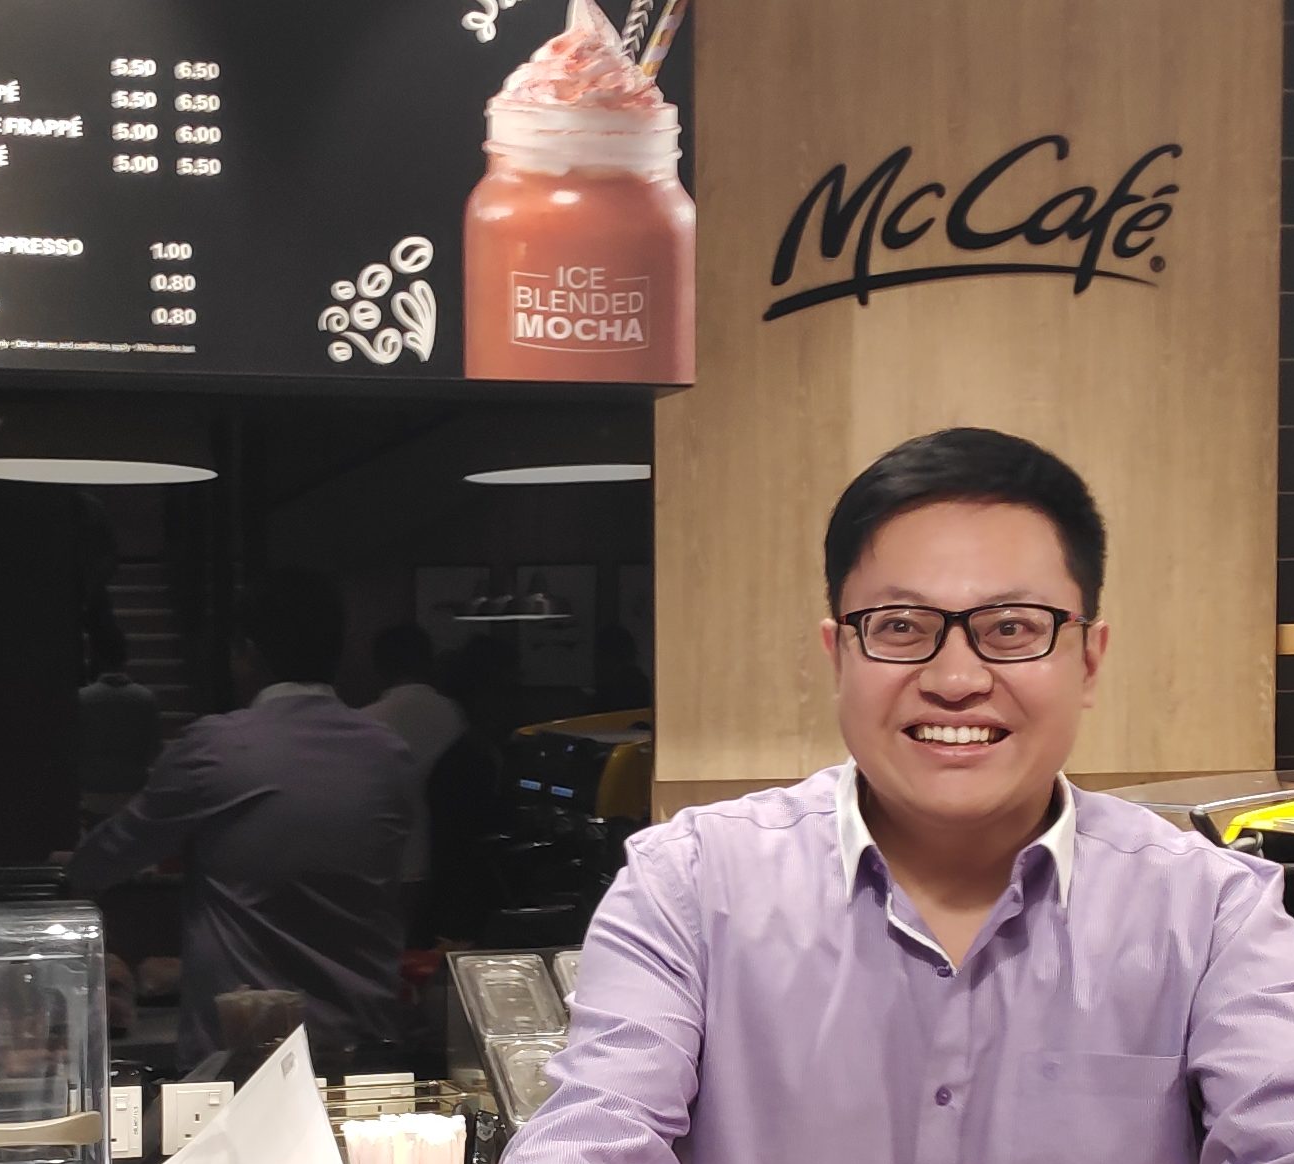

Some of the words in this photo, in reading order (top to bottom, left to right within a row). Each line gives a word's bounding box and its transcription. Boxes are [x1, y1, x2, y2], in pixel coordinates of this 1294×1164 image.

[110, 58, 157, 77] 5.50
[174, 61, 220, 80] 6.50
[111, 90, 157, 109] 5.50
[174, 93, 221, 112] 6.50
[3, 116, 84, 138] FRAPPÉ
[112, 122, 158, 141] 5.00
[175, 125, 221, 144] 6.00
[113, 154, 159, 173] 5.00
[176, 157, 222, 176] 5.50
[771, 135, 1183, 306] McCafé
[149, 242, 192, 260] 1.00
[150, 274, 196, 292] 0.80
[557, 265, 607, 290] ICE
[516, 286, 644, 315] BLENDED
[151, 307, 197, 325] 0.80
[516, 312, 643, 342] MOCHA
